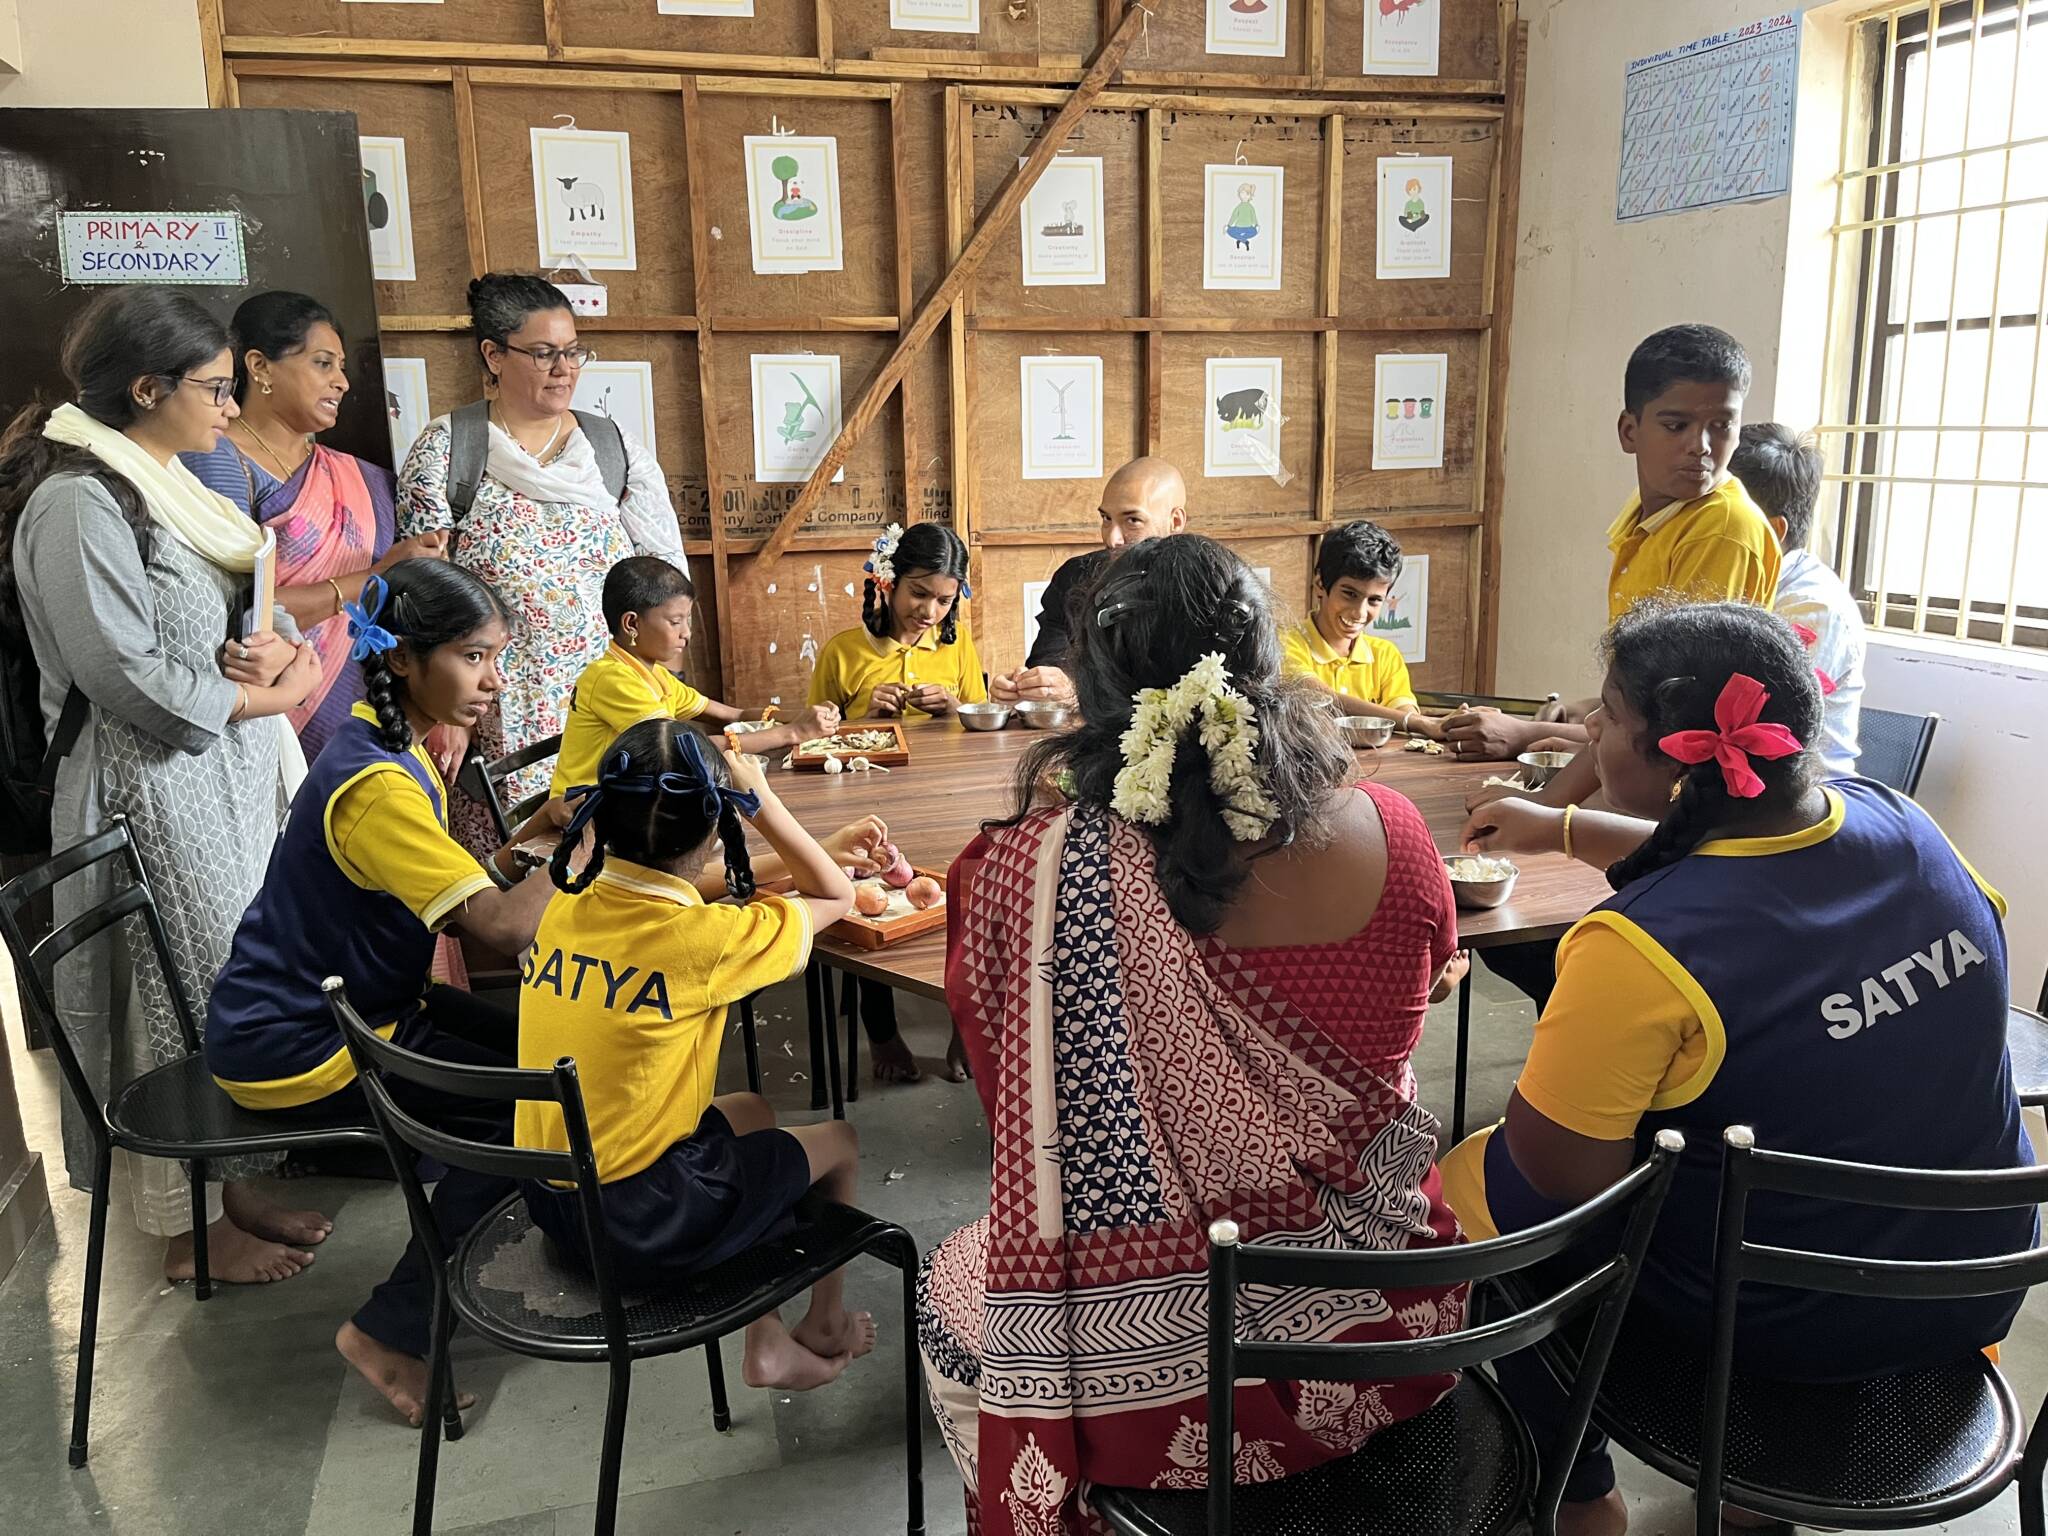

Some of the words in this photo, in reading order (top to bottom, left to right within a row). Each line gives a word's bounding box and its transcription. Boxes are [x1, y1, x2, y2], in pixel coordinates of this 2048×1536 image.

[1630, 51, 1673, 70] INDIVIDUAL
[1678, 42, 1697, 54] TIME
[1702, 33, 1729, 49] TABLE
[82, 251, 220, 271] SECONDARY
[677, 513, 745, 527] Comny
[755, 511, 812, 524] Certd
[818, 511, 884, 524] Company
[523, 940, 673, 1020] SATYA
[1820, 929, 1987, 1040] SATYA
